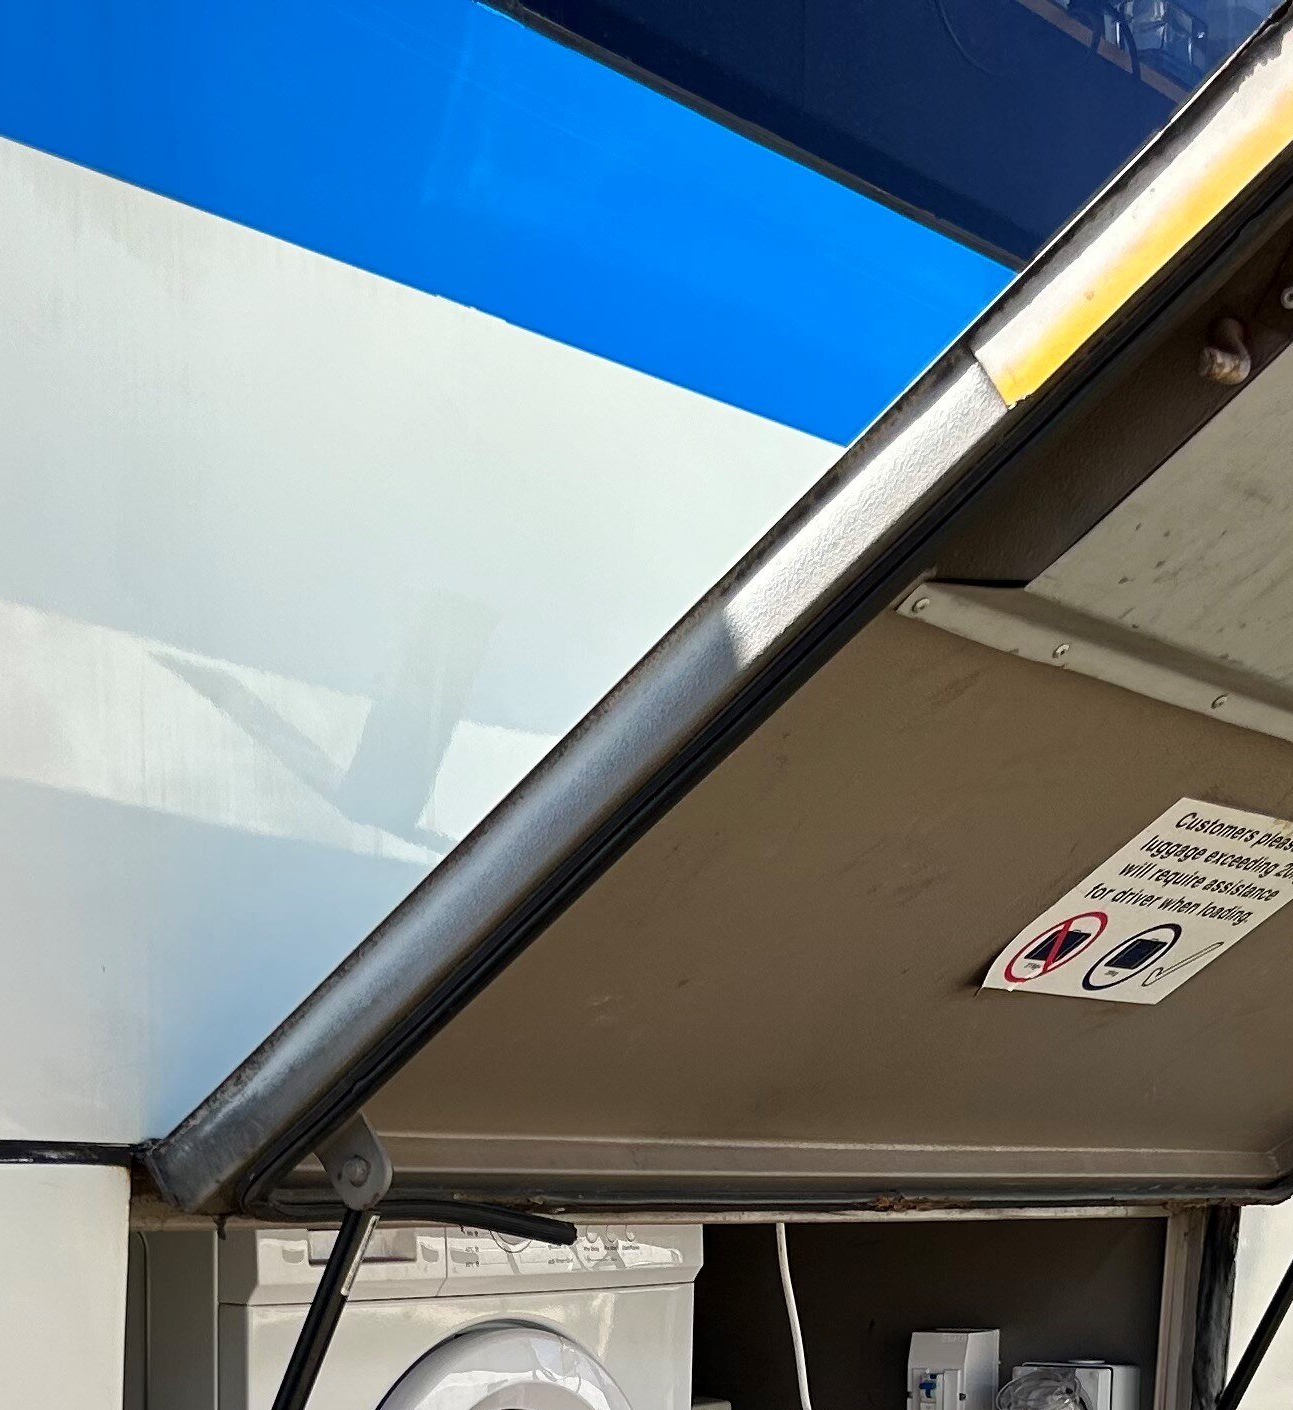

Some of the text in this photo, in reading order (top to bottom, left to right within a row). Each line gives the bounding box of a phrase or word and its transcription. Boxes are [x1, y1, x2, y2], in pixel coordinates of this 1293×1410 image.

[1175, 812, 1260, 842] Customers
[1140, 834, 1208, 863] luggage
[1203, 850, 1280, 879] exceeding
[1119, 862, 1280, 901] will require assistance
[1084, 882, 1254, 926] for driver when loading.
